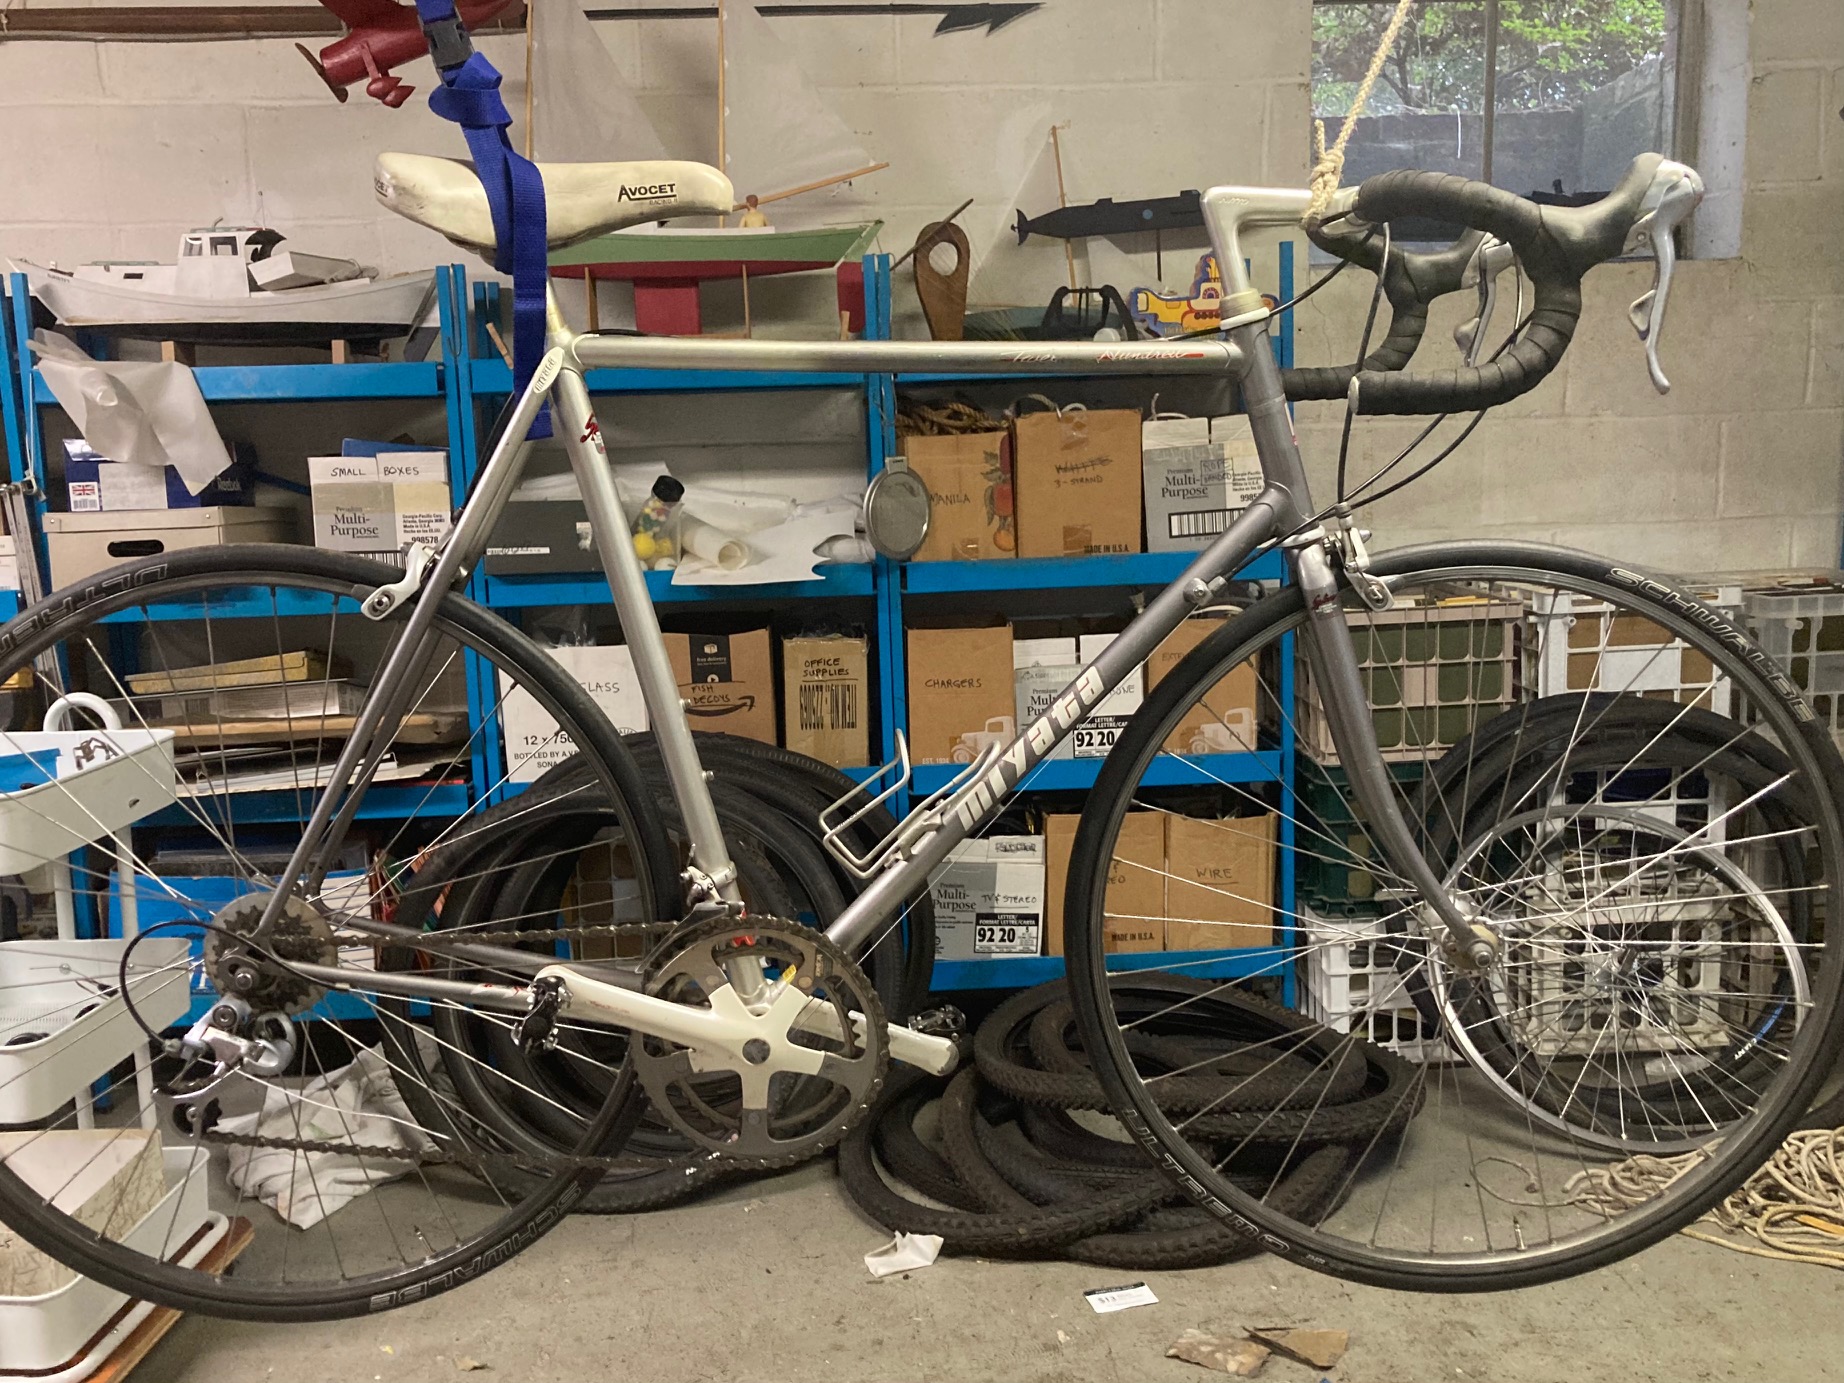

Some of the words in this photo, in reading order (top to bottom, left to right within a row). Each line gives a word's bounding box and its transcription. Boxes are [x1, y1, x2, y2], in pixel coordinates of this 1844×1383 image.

[618, 183, 676, 202] AVOCET
[331, 467, 366, 477] SMALL
[383, 466, 420, 476] BOXES
[1165, 475, 1200, 487] Multi-
[930, 492, 971, 506] MANILA
[1161, 487, 1208, 500] Purpose
[1240, 492, 1258, 502] 9985
[334, 512, 370, 524] Multi-
[330, 525, 379, 539] Purpose
[1605, 567, 1816, 722] SCHWALBE
[804, 658, 841, 668] OFFICE
[803, 667, 850, 677] SUPPLIES
[692, 685, 714, 693] FISH
[925, 679, 982, 688] CHARGERS
[694, 694, 731, 705] DECOYS
[524, 735, 538, 746] 12
[1076, 732, 1094, 747] 92
[1097, 731, 1115, 746] 20
[514, 751, 548, 760] BOTTLED
[550, 751, 559, 759] BY
[1196, 868, 1233, 879] WIRE
[937, 889, 970, 900] Multi-
[981, 894, 995, 903] TV
[1003, 895, 1037, 904] STEREO
[933, 900, 977, 913] Purpose
[977, 927, 995, 943] 92
[998, 927, 1016, 943] 20
[369, 1180, 582, 1312] SCHWALBE
